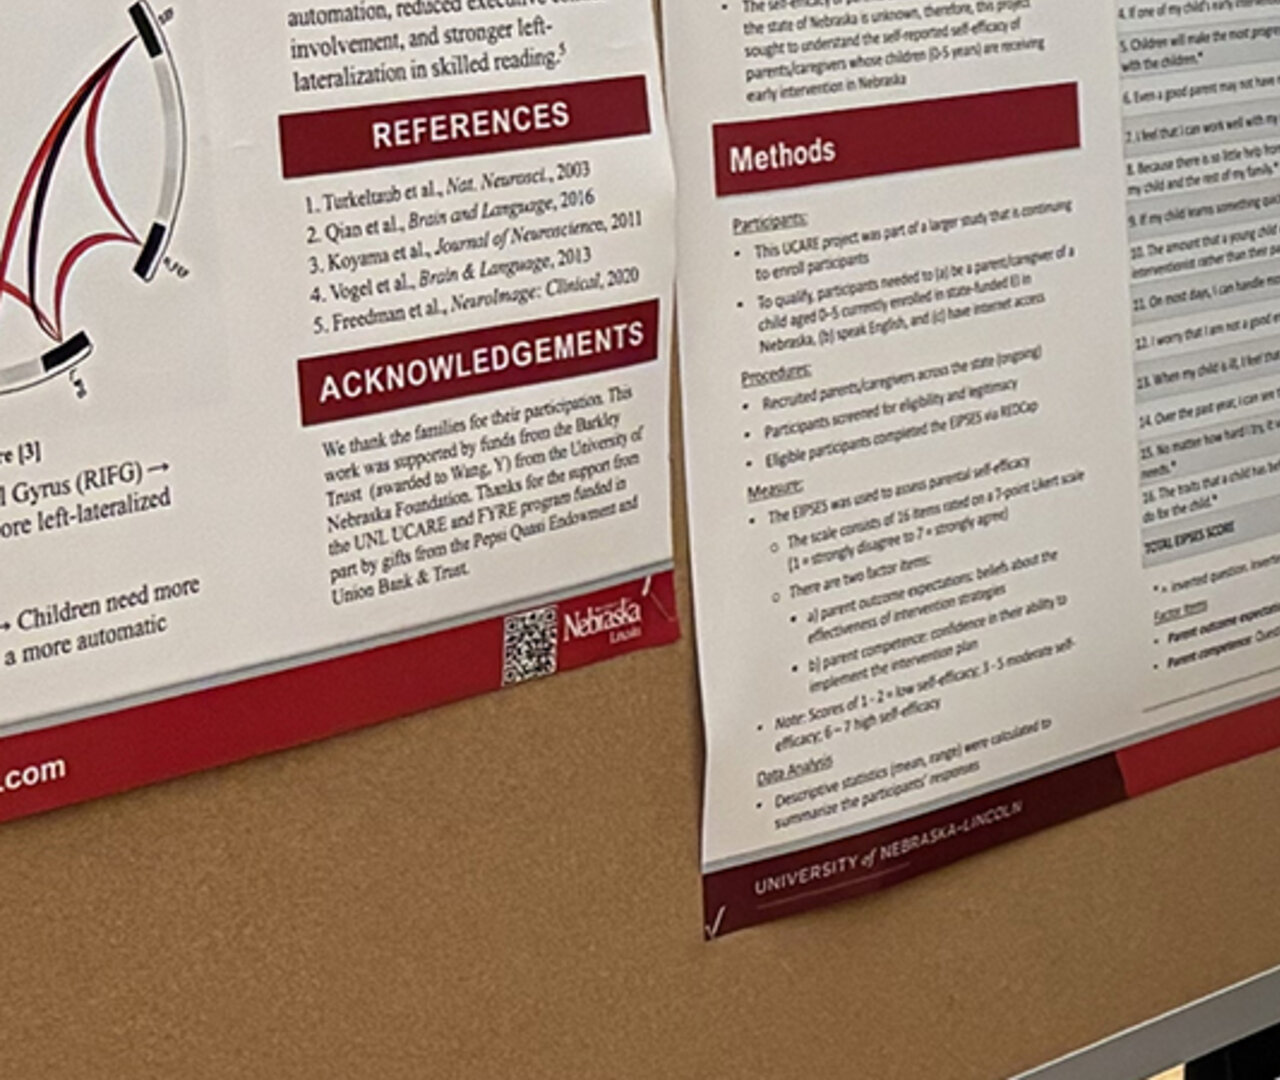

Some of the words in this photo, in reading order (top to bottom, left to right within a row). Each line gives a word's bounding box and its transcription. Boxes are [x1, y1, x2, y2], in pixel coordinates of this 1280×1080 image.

[373, 102, 569, 148] REFERENCES
[730, 138, 836, 173] Methods
[306, 196, 320, 214] 1.
[322, 185, 401, 211] Turkeltaub
[405, 186, 417, 200] et
[421, 180, 443, 197] al.,
[320, 322, 643, 402] ACKNOWLEDGEMENTS
[12, 480, 71, 506] Gyrus
[76, 462, 142, 495] (RIFG)
[38, 486, 171, 531] left-lateralized
[17, 600, 101, 630] Children
[106, 584, 149, 612] need
[154, 579, 199, 601] more
[563, 598, 641, 642] Nebraska
[5, 651, 16, 666] a
[22, 639, 71, 663] more
[77, 617, 166, 651] automatic
[755, 856, 857, 894] UNIVERSITY
[861, 848, 877, 867] of
